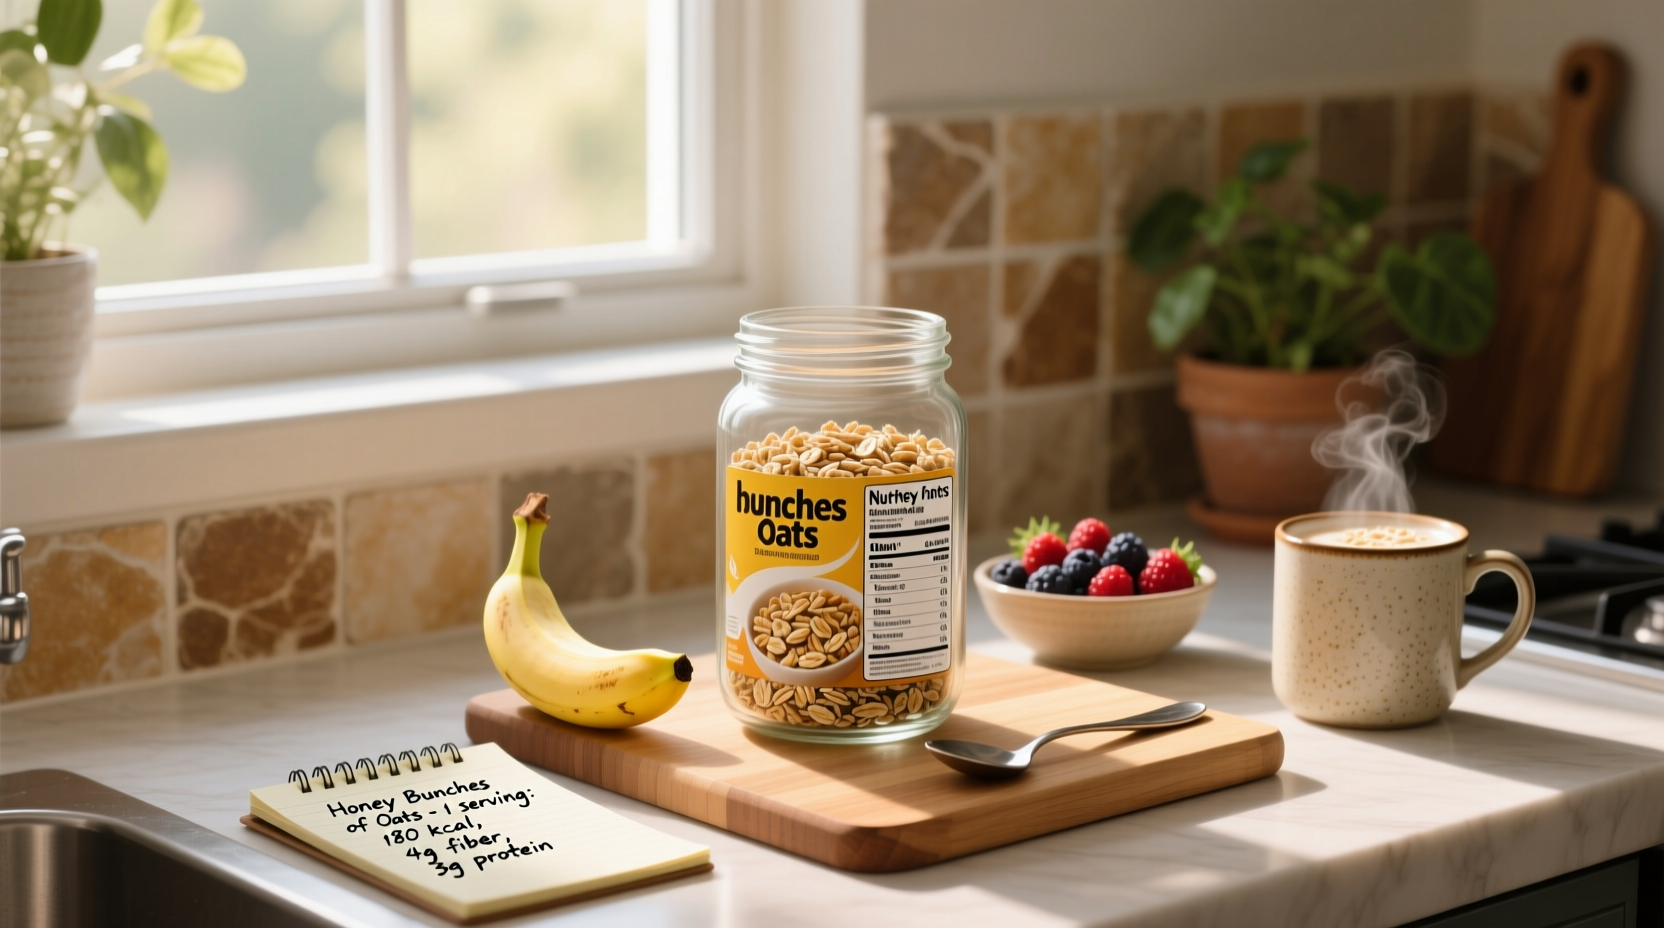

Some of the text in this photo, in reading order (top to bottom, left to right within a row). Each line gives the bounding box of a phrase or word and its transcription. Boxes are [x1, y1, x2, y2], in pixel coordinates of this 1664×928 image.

[757, 518, 819, 549] Oats
[326, 779, 491, 818] Honey Bunches
[346, 816, 368, 833] of
[376, 810, 423, 827] Oats
[458, 788, 535, 812] serving:
[383, 815, 482, 846] 180 kcal,
[406, 832, 511, 865] 4g fiber,
[434, 840, 554, 879] 3g protein
